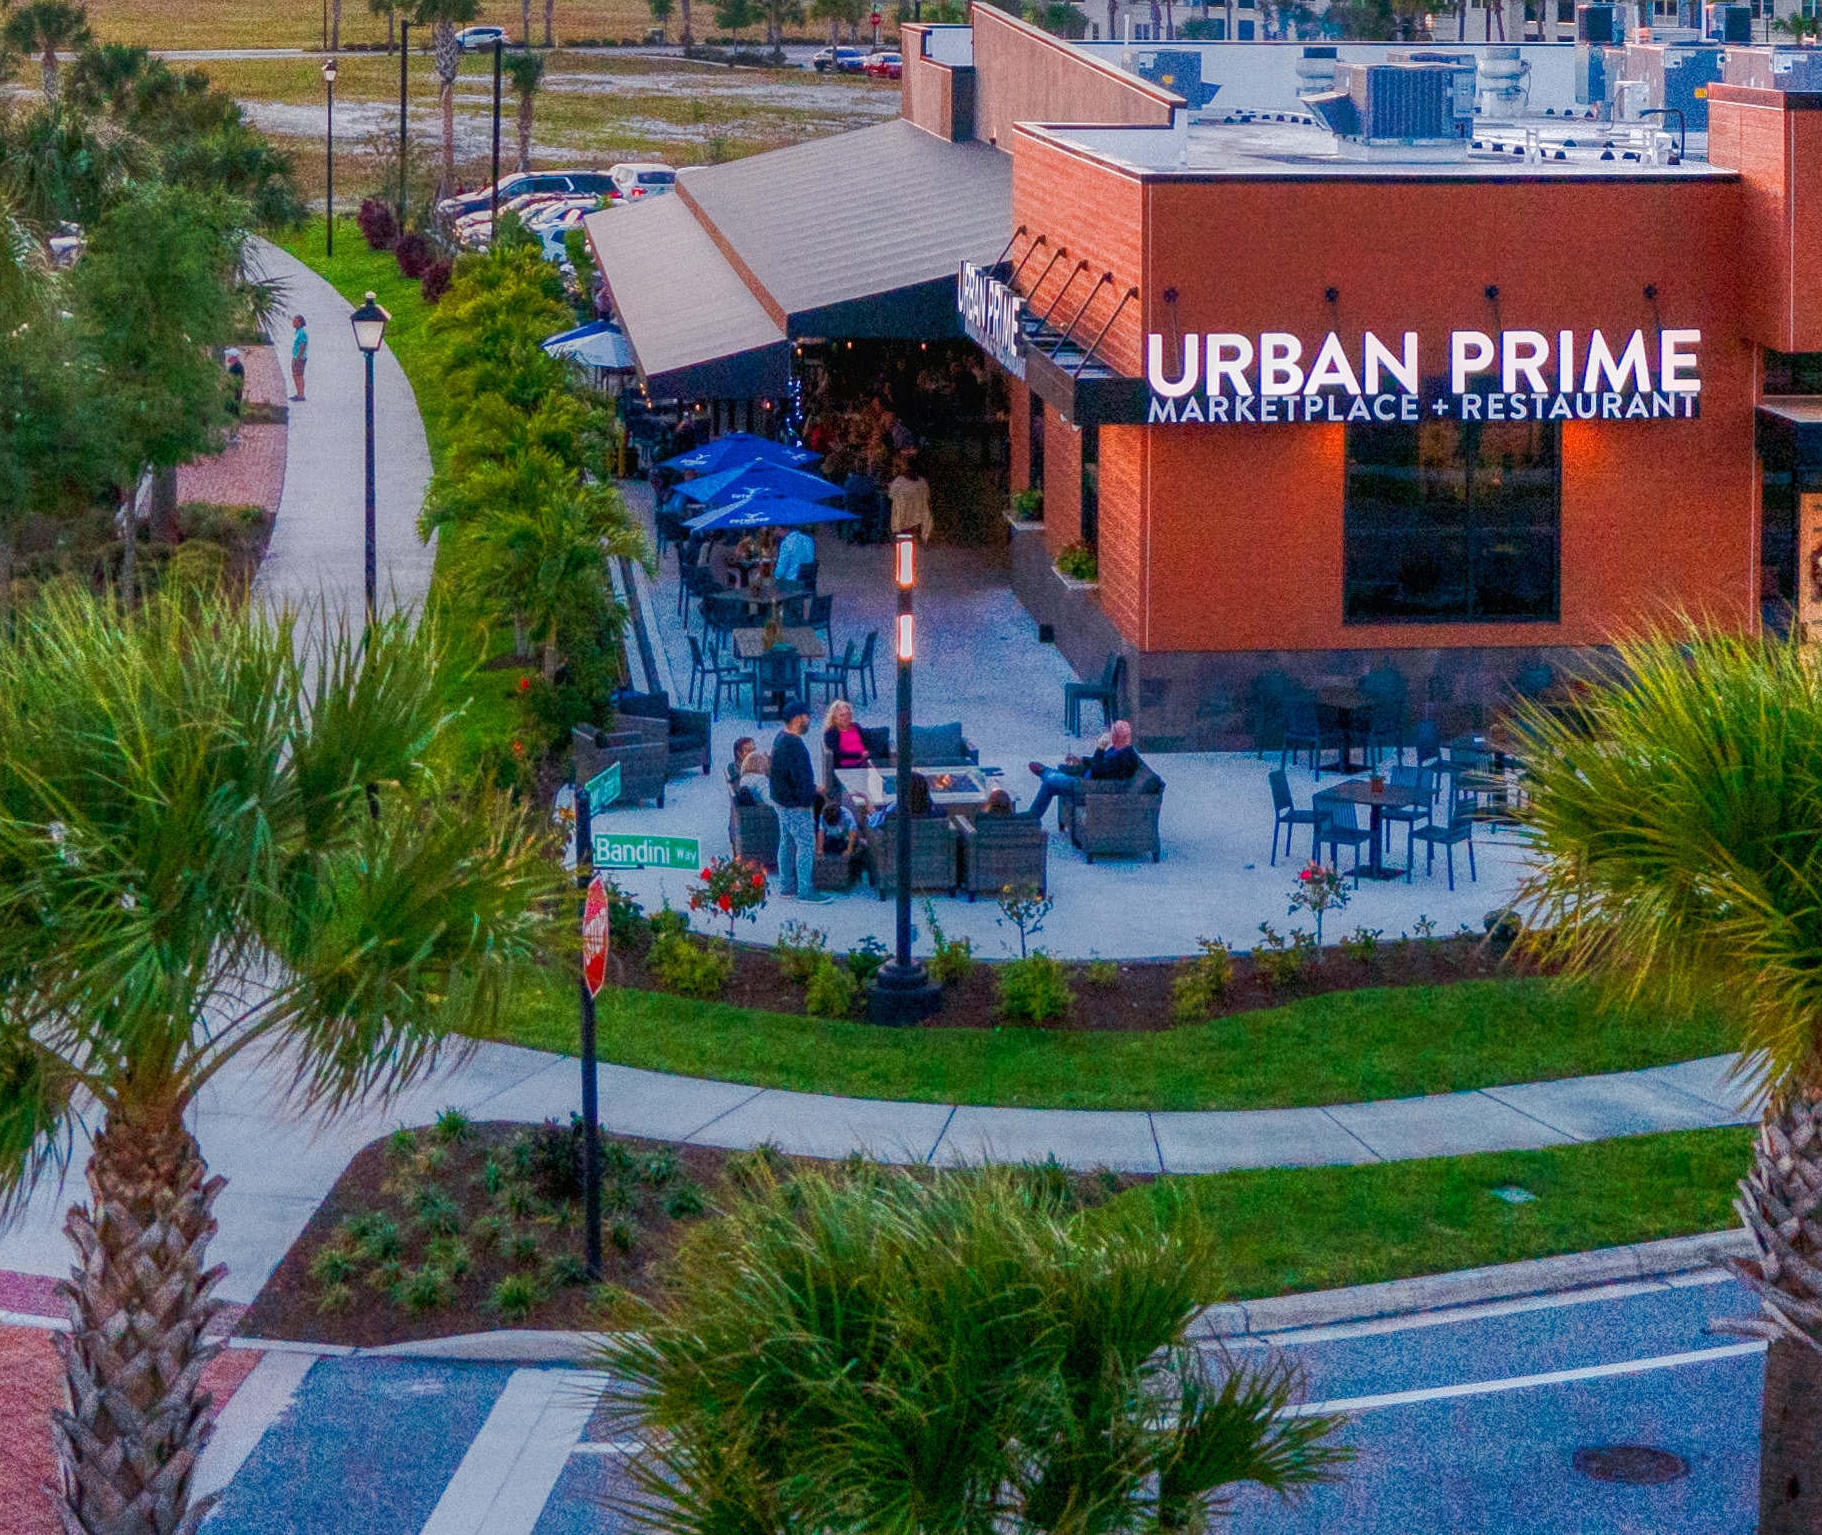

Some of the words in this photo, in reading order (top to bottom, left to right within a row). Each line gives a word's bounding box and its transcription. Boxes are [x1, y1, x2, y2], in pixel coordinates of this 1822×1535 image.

[958, 260, 986, 329] URBAN
[987, 277, 1022, 357] PRIME
[1147, 331, 1418, 397] URBAN
[1451, 328, 1702, 394] PRIME
[1147, 394, 1419, 423] MARKETPLACE
[1461, 391, 1699, 421] RESTAURANT
[595, 837, 671, 864] Bandini
[675, 846, 697, 864] Way
